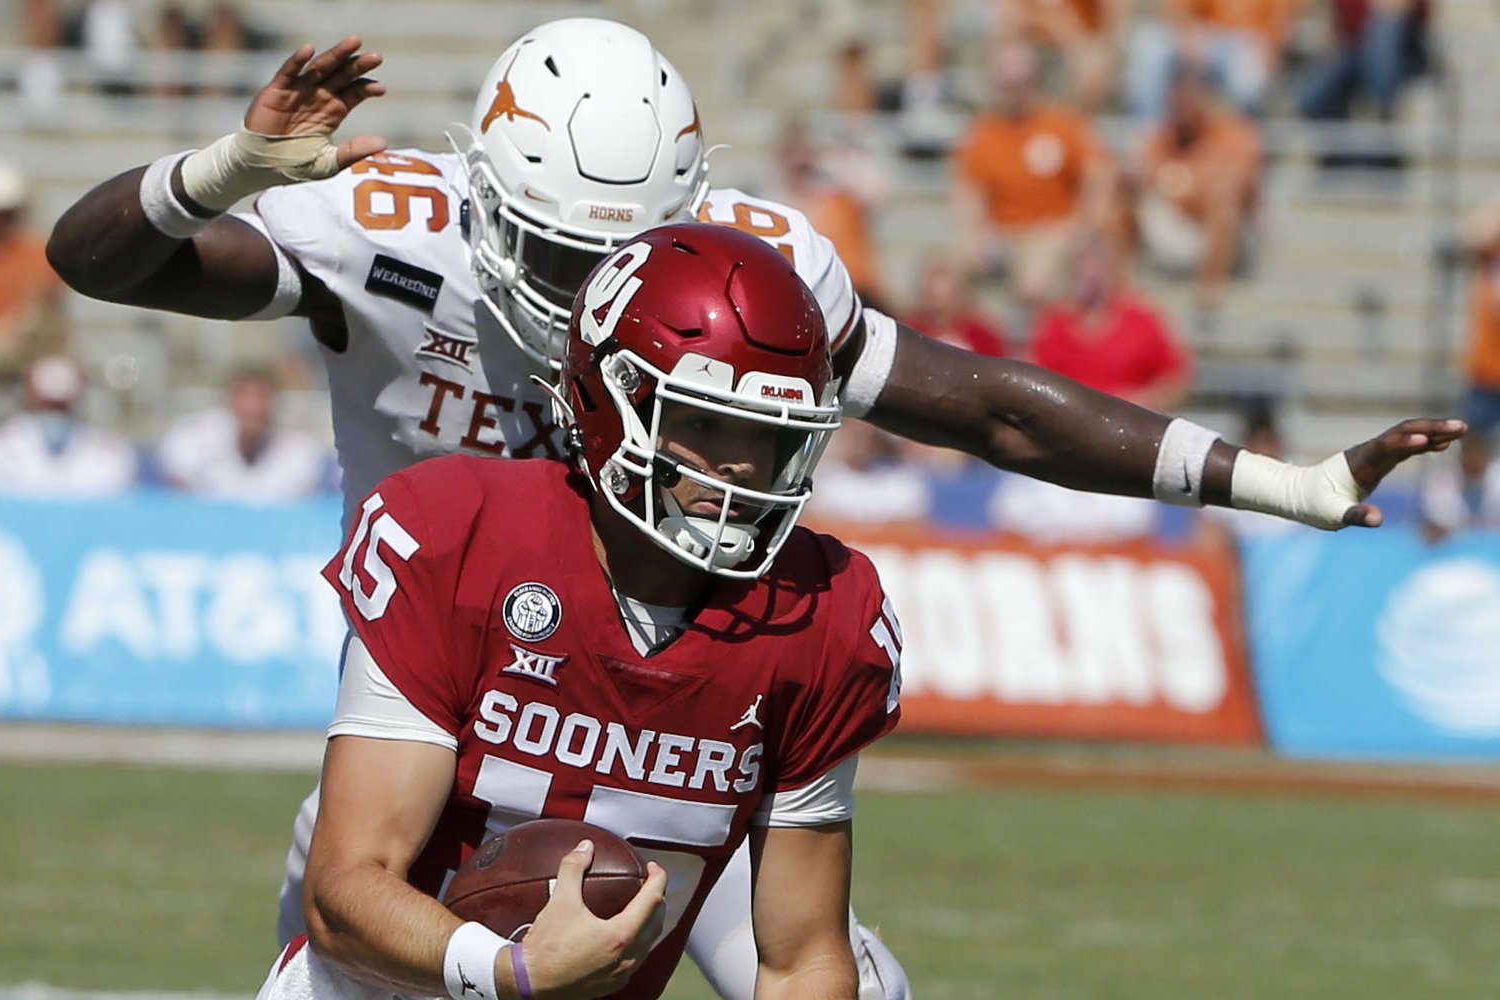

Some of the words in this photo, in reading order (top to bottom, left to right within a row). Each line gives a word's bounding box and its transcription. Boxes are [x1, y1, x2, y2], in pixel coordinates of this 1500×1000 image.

[588, 205, 633, 222] HORNS
[580, 241, 652, 347] OU
[339, 493, 421, 622] 15
[503, 645, 567, 687] XII
[473, 689, 765, 794] SOONERS
